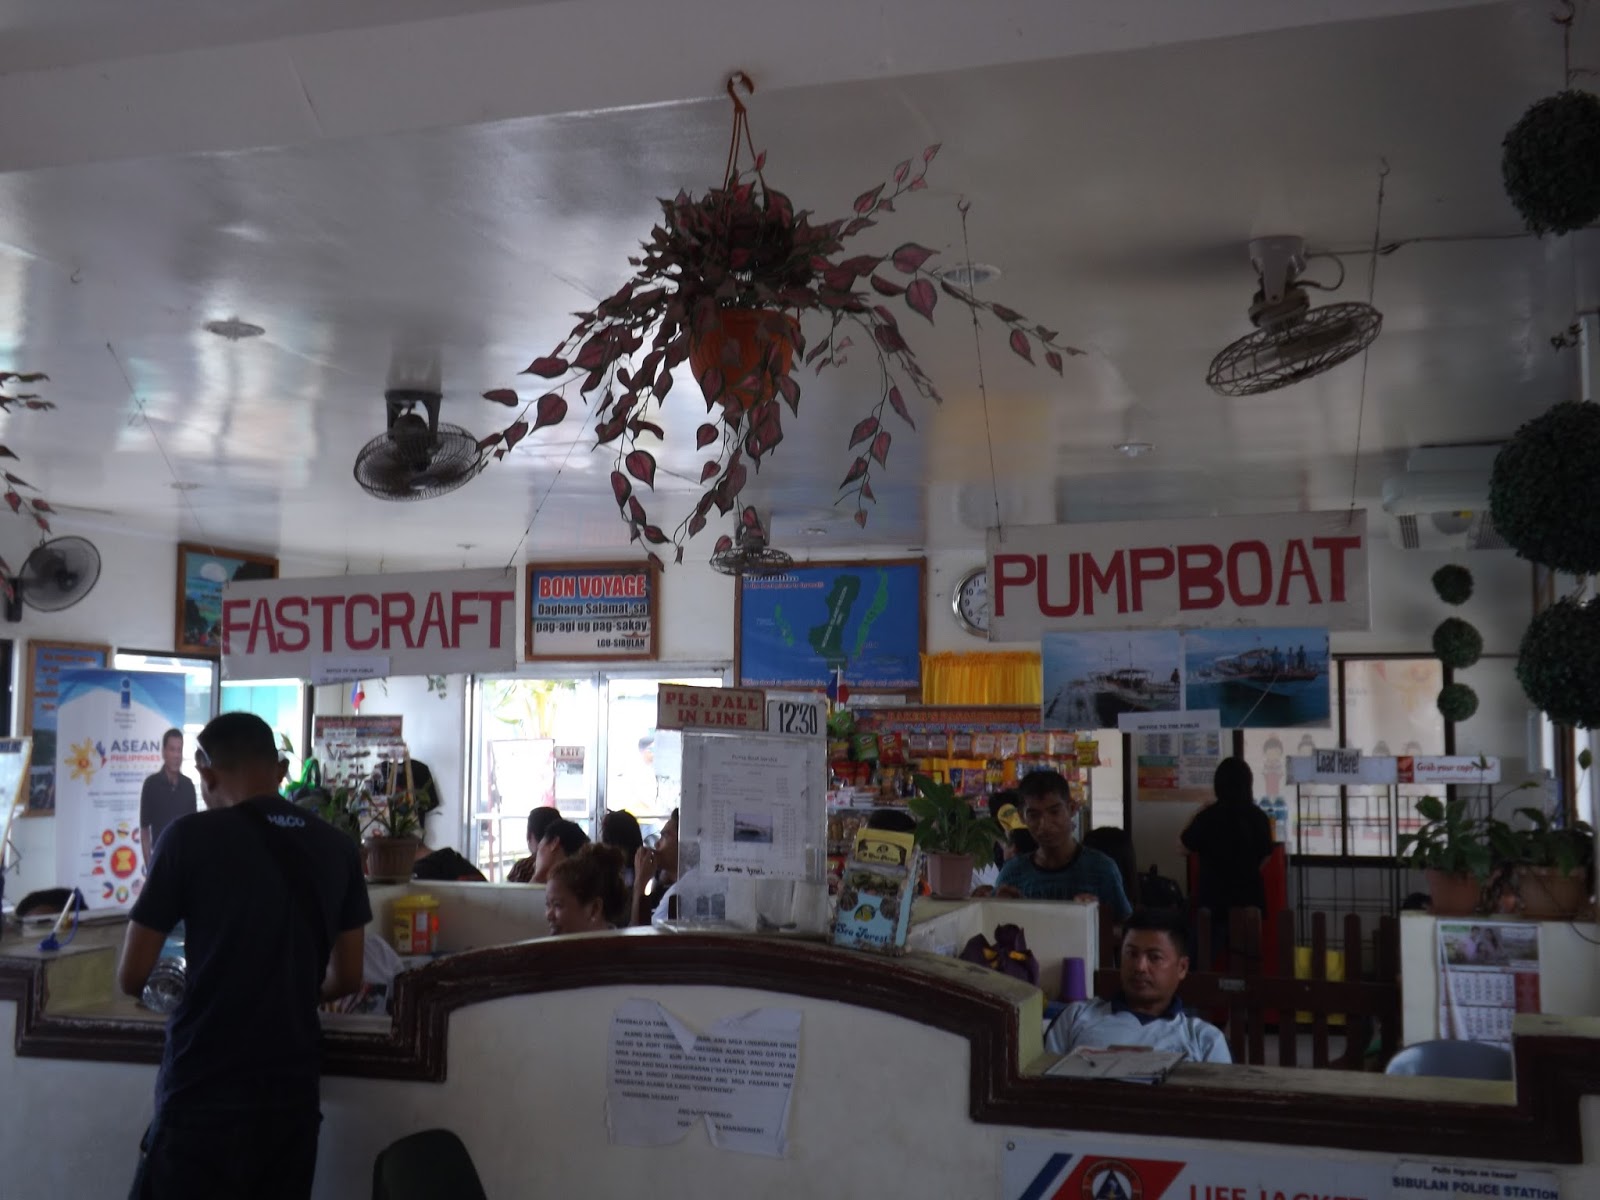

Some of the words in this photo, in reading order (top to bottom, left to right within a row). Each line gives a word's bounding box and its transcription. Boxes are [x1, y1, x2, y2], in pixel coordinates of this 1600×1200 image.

[993, 536, 1361, 618] PUMPBOAT
[538, 576, 576, 600] BON
[578, 574, 647, 599] VOYAGE
[966, 588, 974, 596] 10
[538, 603, 583, 616] Daghang
[633, 604, 647, 615] sa
[964, 599, 970, 607] 9
[221, 591, 515, 655] FASTCRAFT
[536, 620, 575, 633] pag-agi
[577, 622, 591, 632] ug
[665, 691, 704, 707] PLS.
[712, 695, 758, 711] FALL
[678, 709, 697, 723] IN
[704, 711, 747, 726] LINE
[111, 740, 161, 752] ASEAN
[560, 747, 580, 757] EXIT
[836, 922, 854, 937] Sea
[855, 925, 888, 943] Forest
[1392, 1176, 1449, 1191] SIBULAN
[1452, 1181, 1500, 1196] POLICE
[1503, 1185, 1559, 1200] STATION
